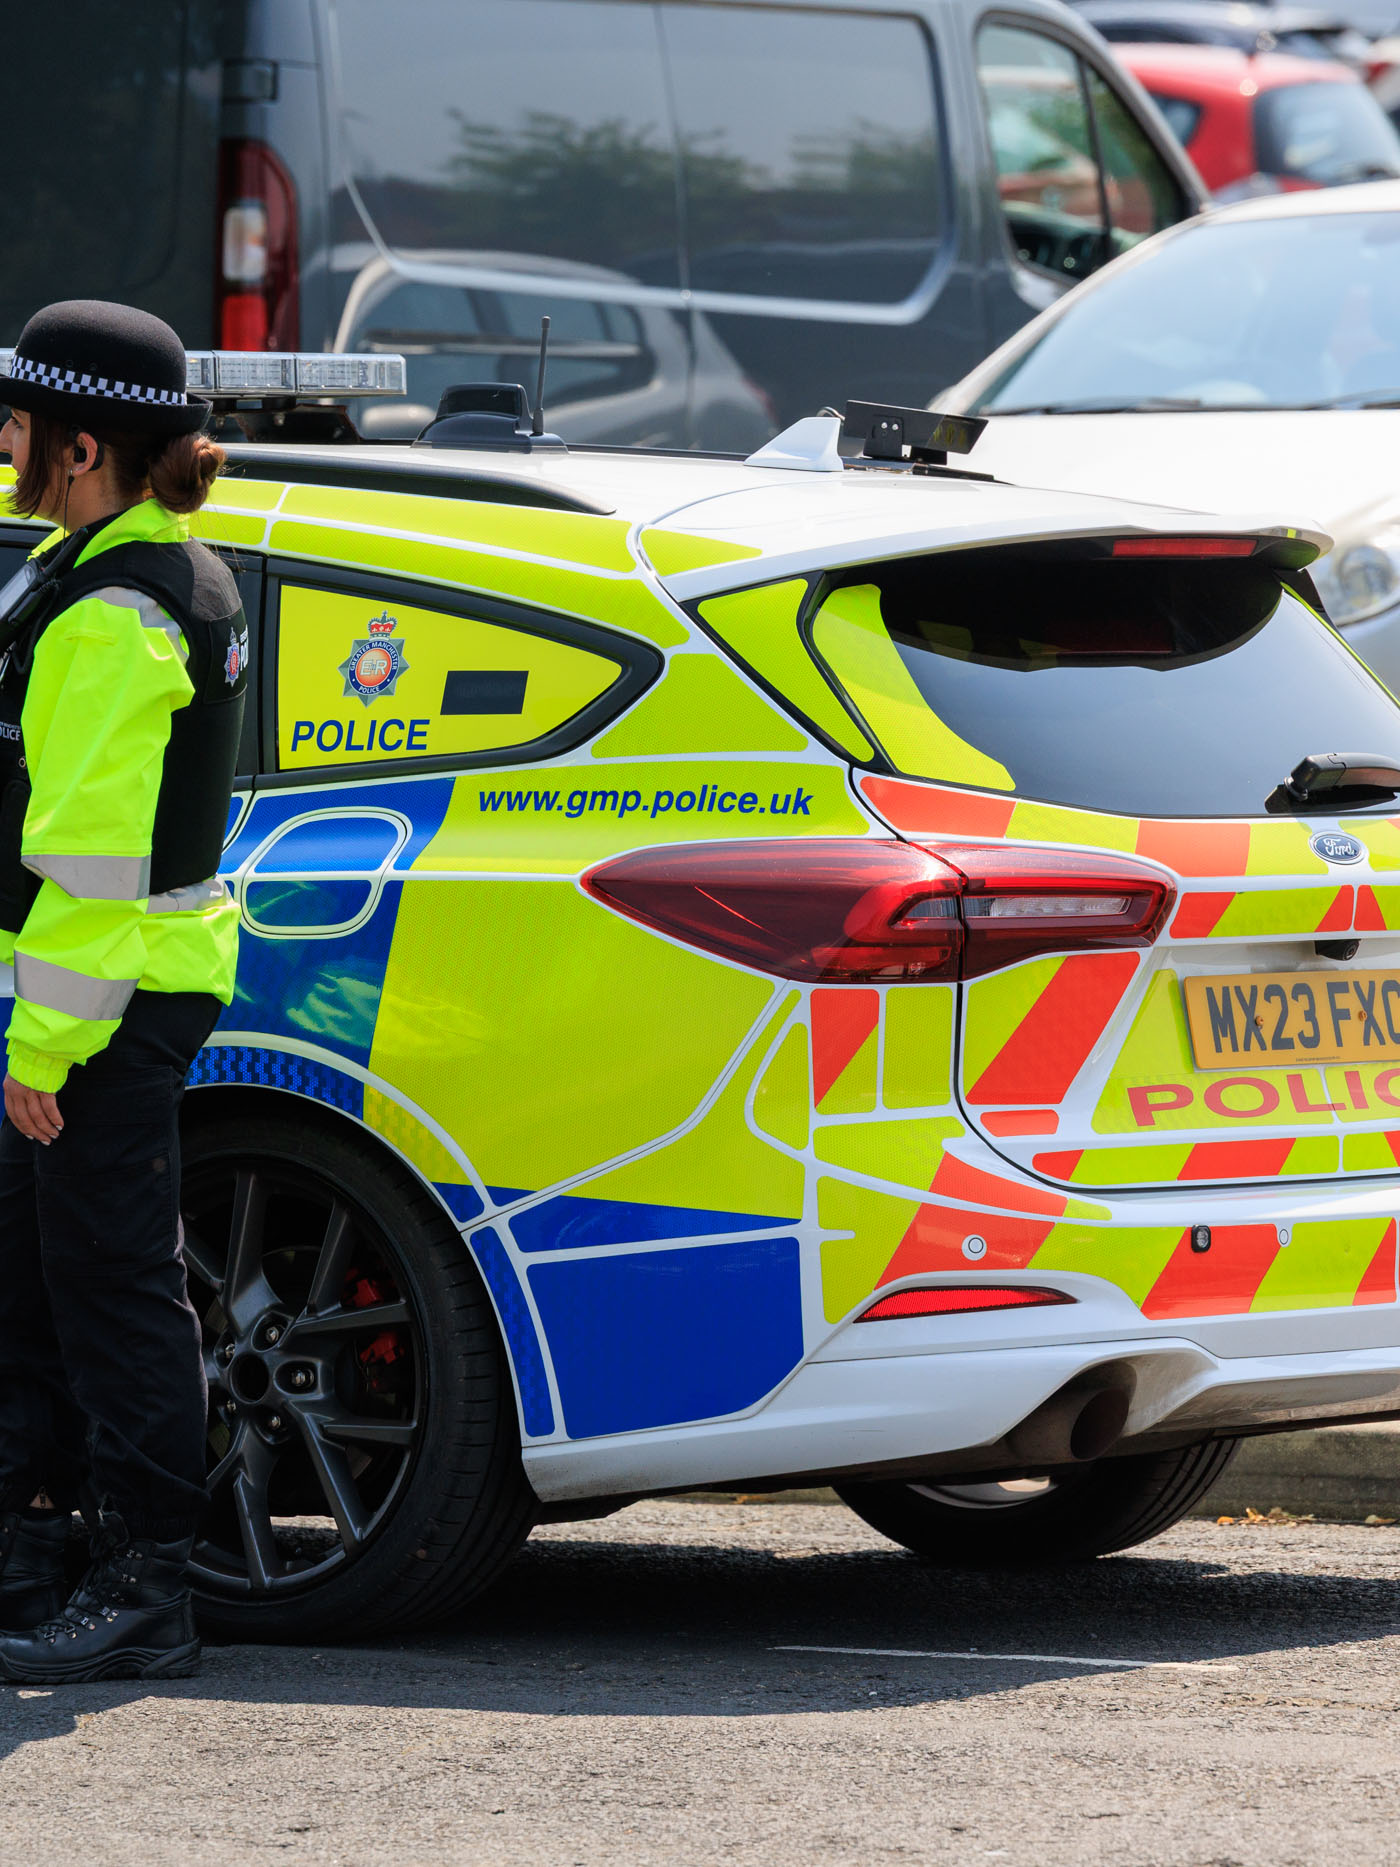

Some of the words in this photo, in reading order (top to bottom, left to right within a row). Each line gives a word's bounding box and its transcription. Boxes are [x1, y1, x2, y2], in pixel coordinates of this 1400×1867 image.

[350, 644, 370, 671] GREATER
[371, 640, 398, 670] MANCHESTER
[358, 685, 380, 694] POLICE
[291, 718, 430, 752] POLICE
[479, 784, 814, 819] www.gmp.police.uk
[1322, 837, 1357, 857] Ford
[1205, 982, 1321, 1053] MX23
